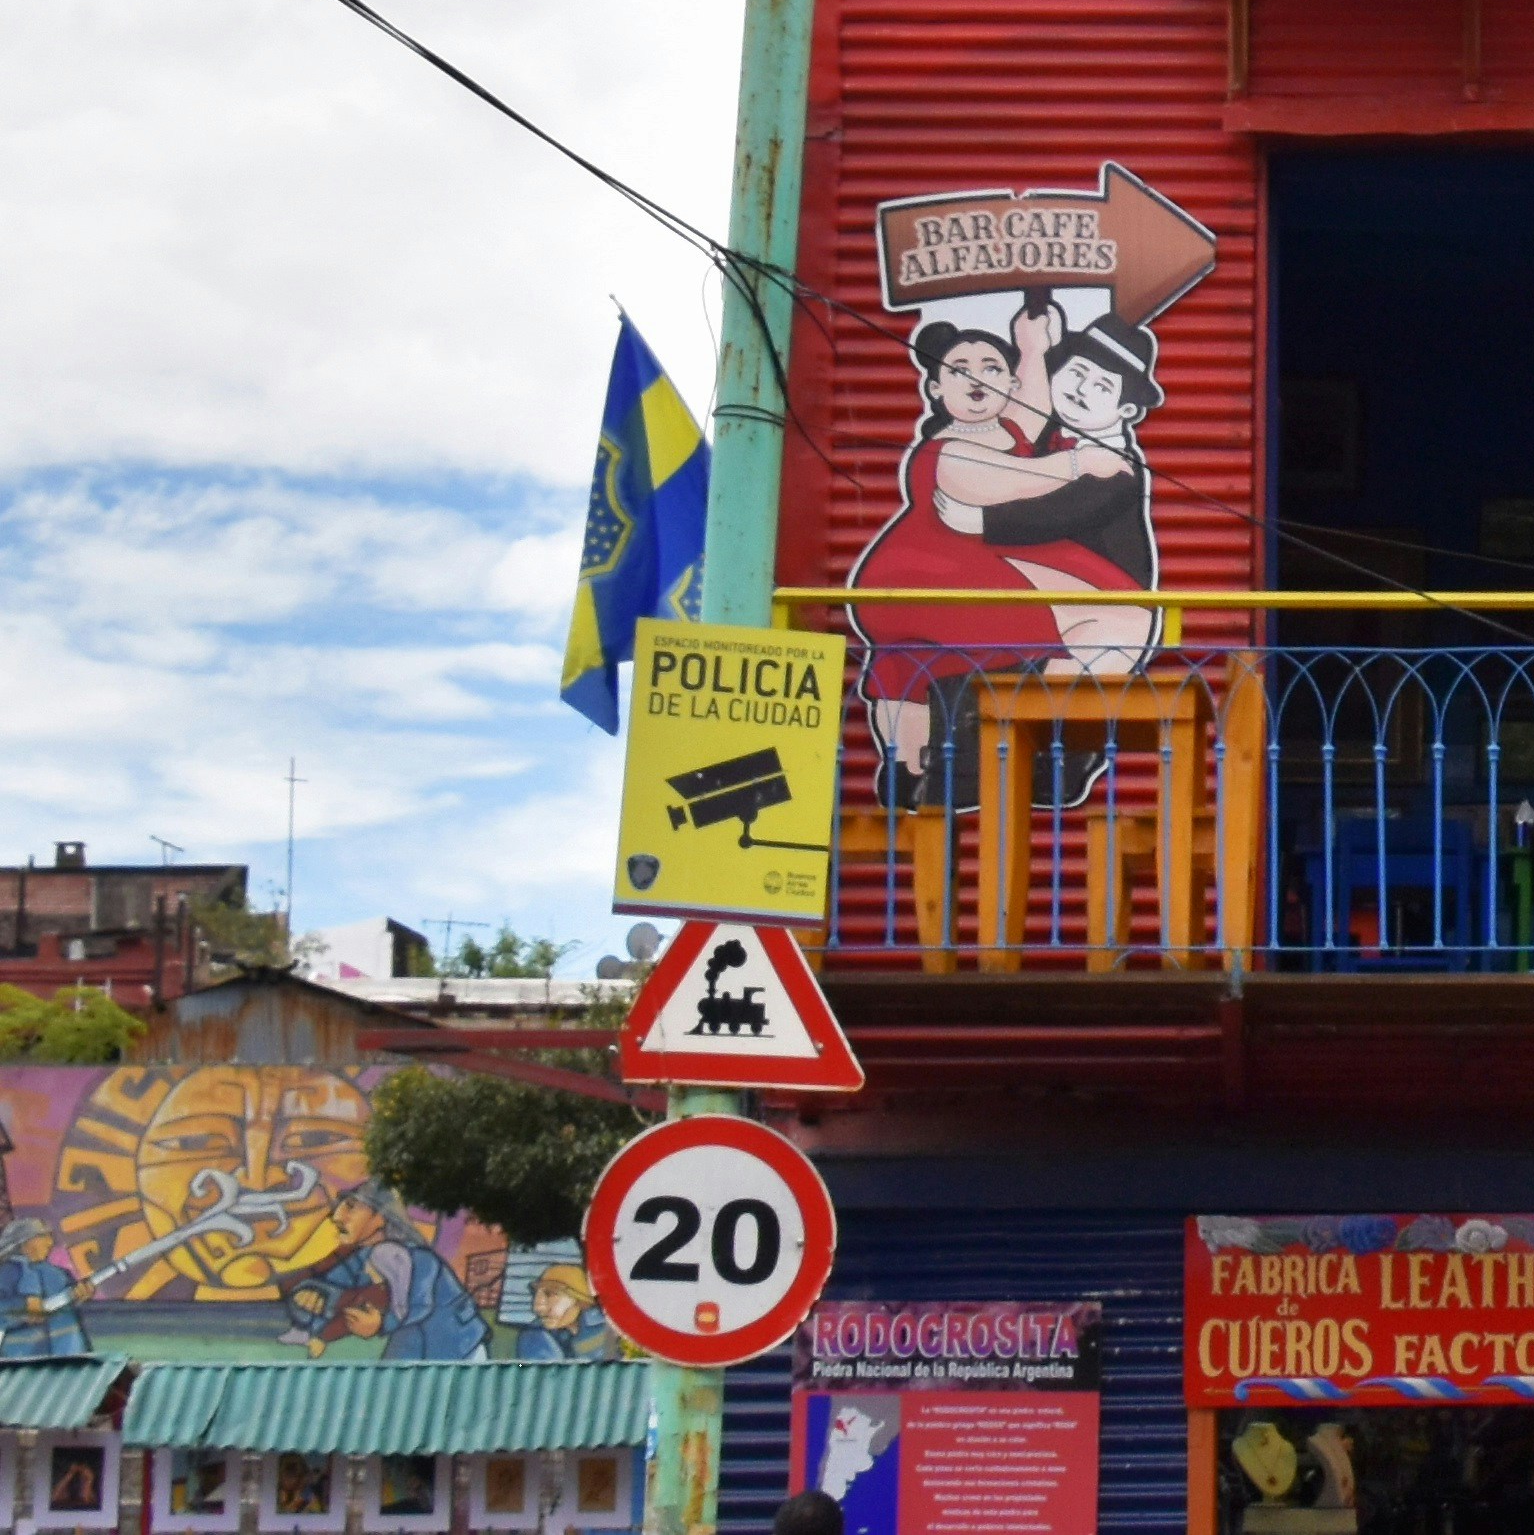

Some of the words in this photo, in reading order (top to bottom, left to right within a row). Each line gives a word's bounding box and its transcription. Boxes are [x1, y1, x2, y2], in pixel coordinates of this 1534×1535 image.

[919, 213, 996, 248] BAR
[1003, 211, 1097, 240] CAFE
[903, 240, 1116, 283] ALFAJORES
[653, 635, 701, 650] ESPACIO
[703, 639, 783, 657] MONITOREADO
[786, 647, 808, 660] POR
[811, 650, 825, 661] LA
[650, 650, 822, 702] POLICIA
[648, 691, 683, 717] DE
[690, 694, 721, 722] LA
[728, 698, 821, 729] CIUDAD
[629, 1194, 781, 1286] 20
[1210, 1254, 1363, 1299] FABRICA
[1275, 1297, 1299, 1317] de
[812, 1312, 1080, 1359] RODOCROSITA
[1199, 1317, 1374, 1378] CUEROS
[812, 1361, 853, 1378] Piedra
[857, 1361, 911, 1378] Nacional
[914, 1362, 930, 1378] de
[933, 1362, 945, 1378] la
[949, 1360, 1010, 1381] República
[1013, 1362, 1075, 1382] Argentina
